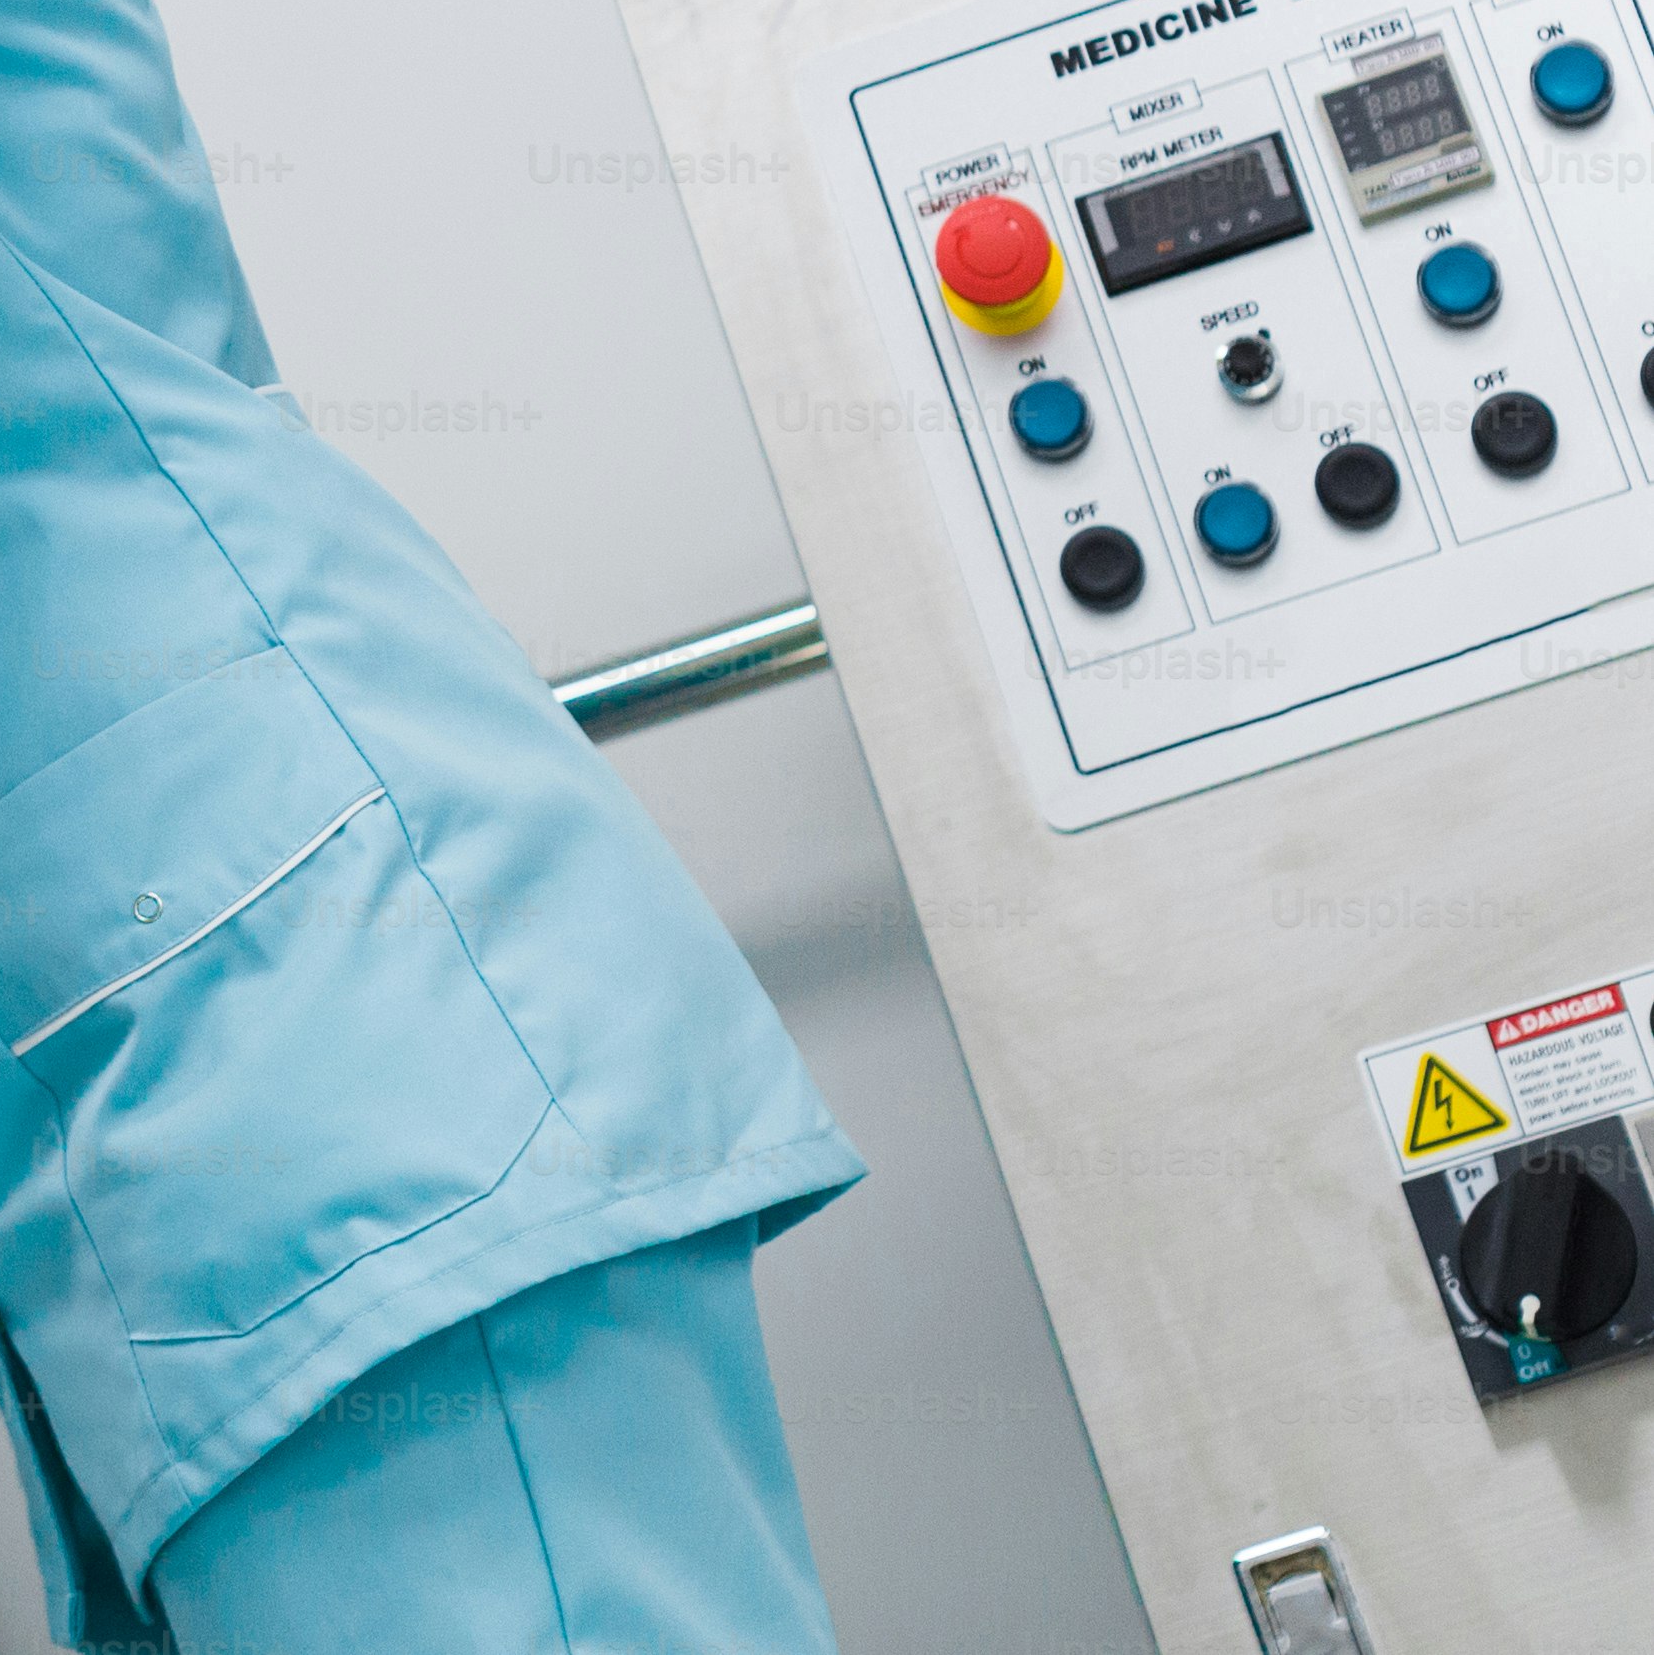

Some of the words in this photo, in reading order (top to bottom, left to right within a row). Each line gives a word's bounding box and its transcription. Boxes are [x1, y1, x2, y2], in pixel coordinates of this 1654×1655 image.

[1333, 19, 1404, 54] HEATER
[1537, 22, 1565, 42] ON
[1129, 91, 1182, 123] MIXER
[1120, 148, 1161, 174] RPM
[1166, 128, 1223, 161] METER
[936, 154, 1000, 185] POWER
[919, 169, 1031, 218] EMERGENCY
[1425, 222, 1453, 242] ON
[1201, 302, 1259, 331] SPEED
[1019, 355, 1047, 377] ON
[1474, 368, 1510, 392] OFF
[1320, 425, 1354, 449] OFF
[1203, 463, 1232, 485] ON
[1064, 502, 1100, 525] OFF
[1520, 990, 1615, 1034] DANGER
[1509, 1040, 1575, 1066] HAZARDOUS
[1579, 1023, 1625, 1044] VOLTAGE
[1455, 1166, 1483, 1182] On
[1519, 1360, 1550, 1379] Off
